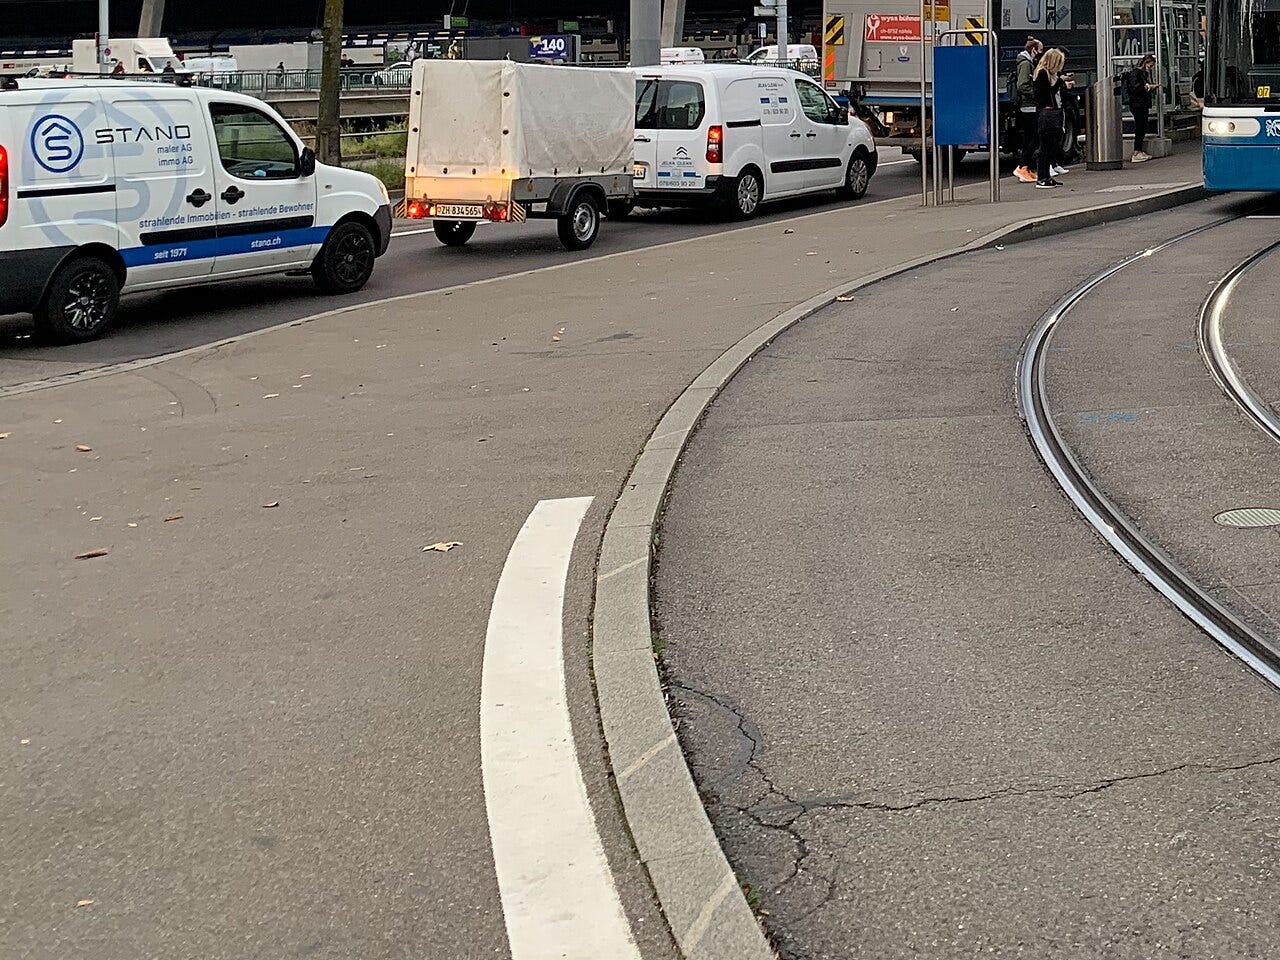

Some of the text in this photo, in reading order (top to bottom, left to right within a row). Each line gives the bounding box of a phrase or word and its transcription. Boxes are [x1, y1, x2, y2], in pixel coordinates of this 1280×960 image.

[542, 38, 565, 51] 140
[157, 143, 193, 154] maler AG
[158, 155, 194, 166] immo AG
[139, 215, 186, 228] strahlende
[187, 211, 231, 224] Immobilien
[238, 206, 278, 218] strahlende
[279, 202, 314, 214] Bewohner
[441, 205, 451, 215] ZH
[154, 247, 188, 260] seit 1971
